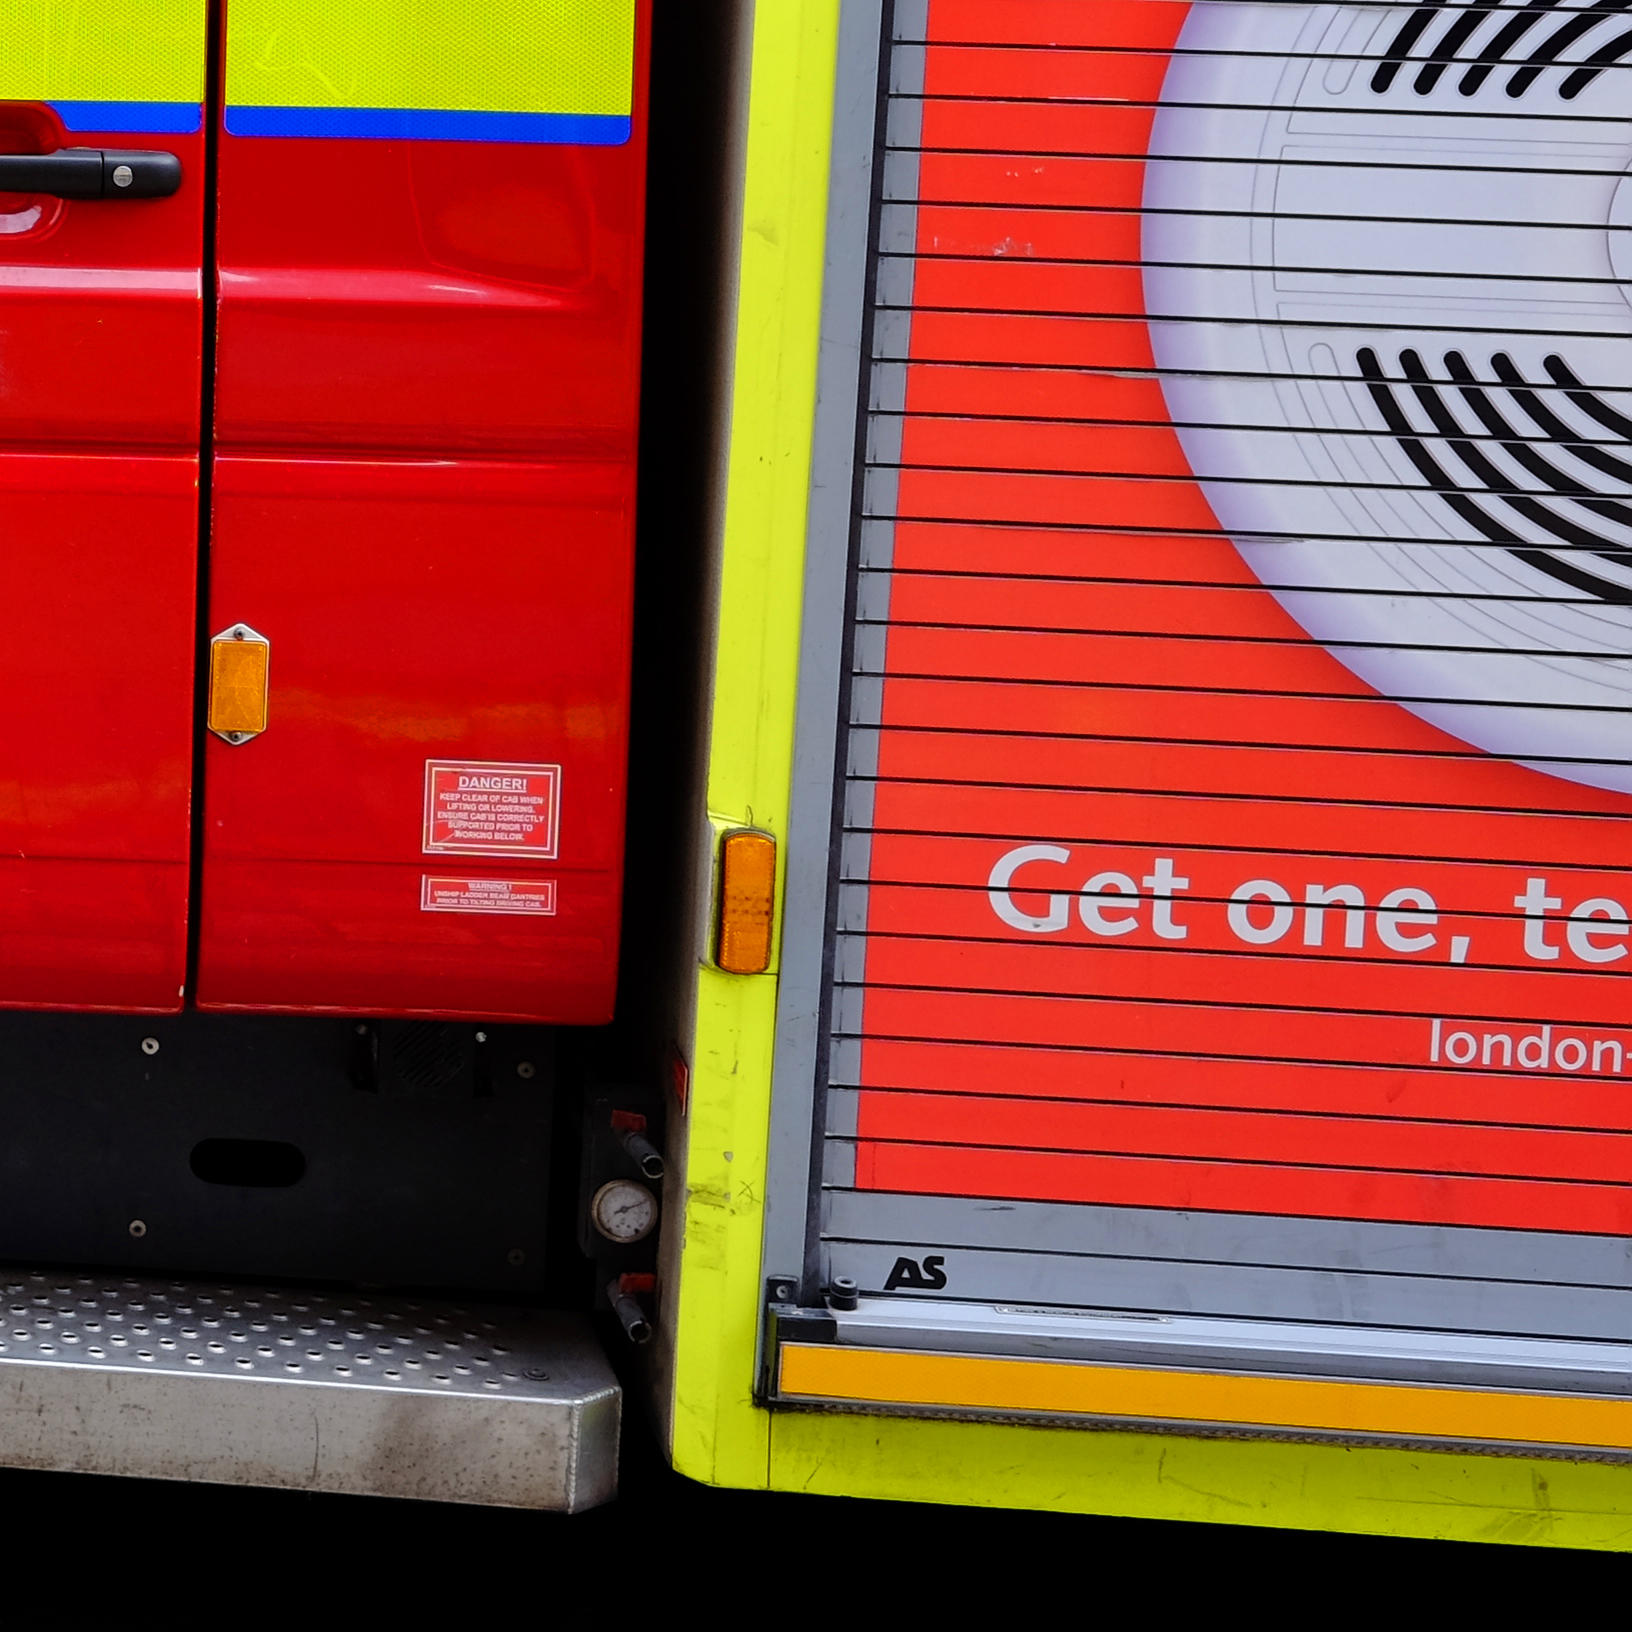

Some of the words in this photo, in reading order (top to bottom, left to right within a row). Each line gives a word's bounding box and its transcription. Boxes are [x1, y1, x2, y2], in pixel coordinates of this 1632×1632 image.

[458, 776, 527, 790] DANGER!
[462, 793, 488, 802] CLEAR
[502, 795, 518, 803] CAB
[447, 802, 476, 811] LIFTING
[478, 803, 490, 811] OR
[497, 813, 544, 823] CORRECTLY
[496, 822, 520, 831] PRIOR
[522, 824, 533, 832] TO
[988, 844, 1189, 940] Get
[1227, 875, 1471, 964] one,
[1514, 878, 1632, 963] te
[883, 1255, 947, 1291] AS
